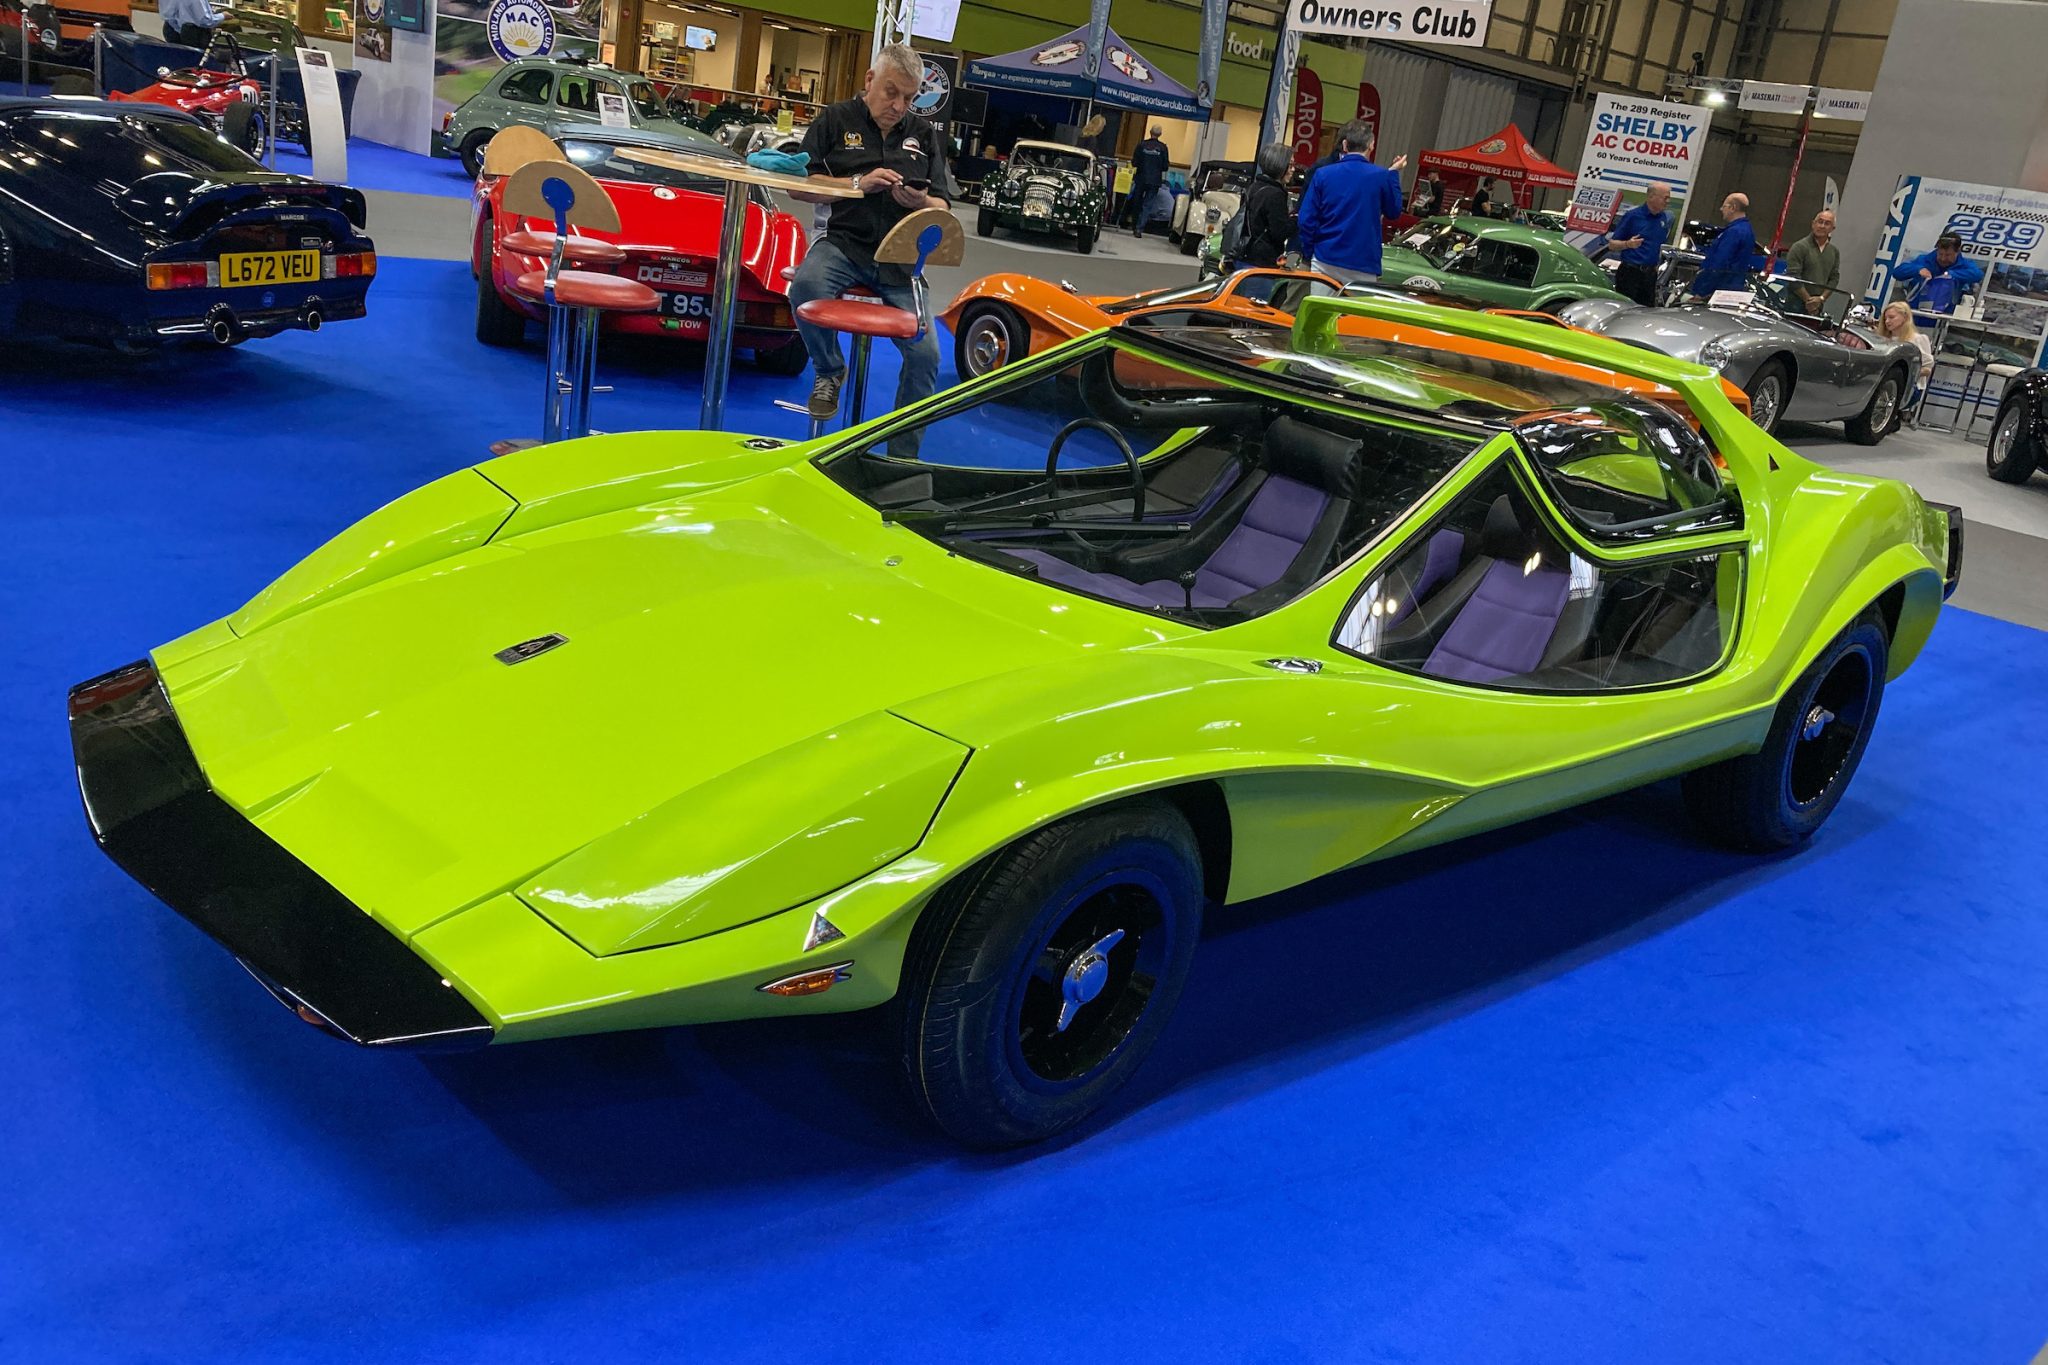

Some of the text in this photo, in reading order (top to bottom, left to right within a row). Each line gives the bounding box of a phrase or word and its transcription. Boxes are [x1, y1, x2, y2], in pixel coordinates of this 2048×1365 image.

[491, 3, 506, 41] MIDLAND
[542, 27, 552, 49] CLUB
[505, 12, 540, 27] MAC
[1299, 0, 1477, 39] Owners Club
[1227, 31, 1263, 60] food
[971, 63, 997, 79] Morgan
[1008, 74, 1035, 84] experience
[1034, 78, 1049, 86] never
[1049, 78, 1072, 88] forgotten
[1101, 84, 1197, 113] www.morgansportscarclub.com
[1751, 91, 1781, 102] MASERATI
[1828, 99, 1860, 110] MASERATI
[921, 105, 938, 114] CLUB
[1610, 101, 1692, 121] The 289 Register
[1294, 91, 1318, 154] AROC
[1596, 112, 1697, 144] SHELBY
[1591, 133, 1690, 161] AC COBRA
[1423, 155, 1523, 179] ALFA ROMEO OWNERS CLUB
[1596, 151, 1679, 171] 60 Years Celebration
[980, 197, 996, 207] 258
[1577, 189, 1613, 203] 289
[1924, 187, 2048, 210] www.the289registe
[1574, 208, 1612, 224] NEWS
[1956, 203, 1985, 214] THE
[1944, 213, 2044, 250] 289
[660, 255, 691, 263] MARCOS
[1864, 184, 1914, 321] BRA
[228, 254, 314, 283] L672 VEU
[637, 265, 664, 282] DG
[679, 320, 701, 329] TOW
[1942, 381, 1995, 395] ENTHSIATS
